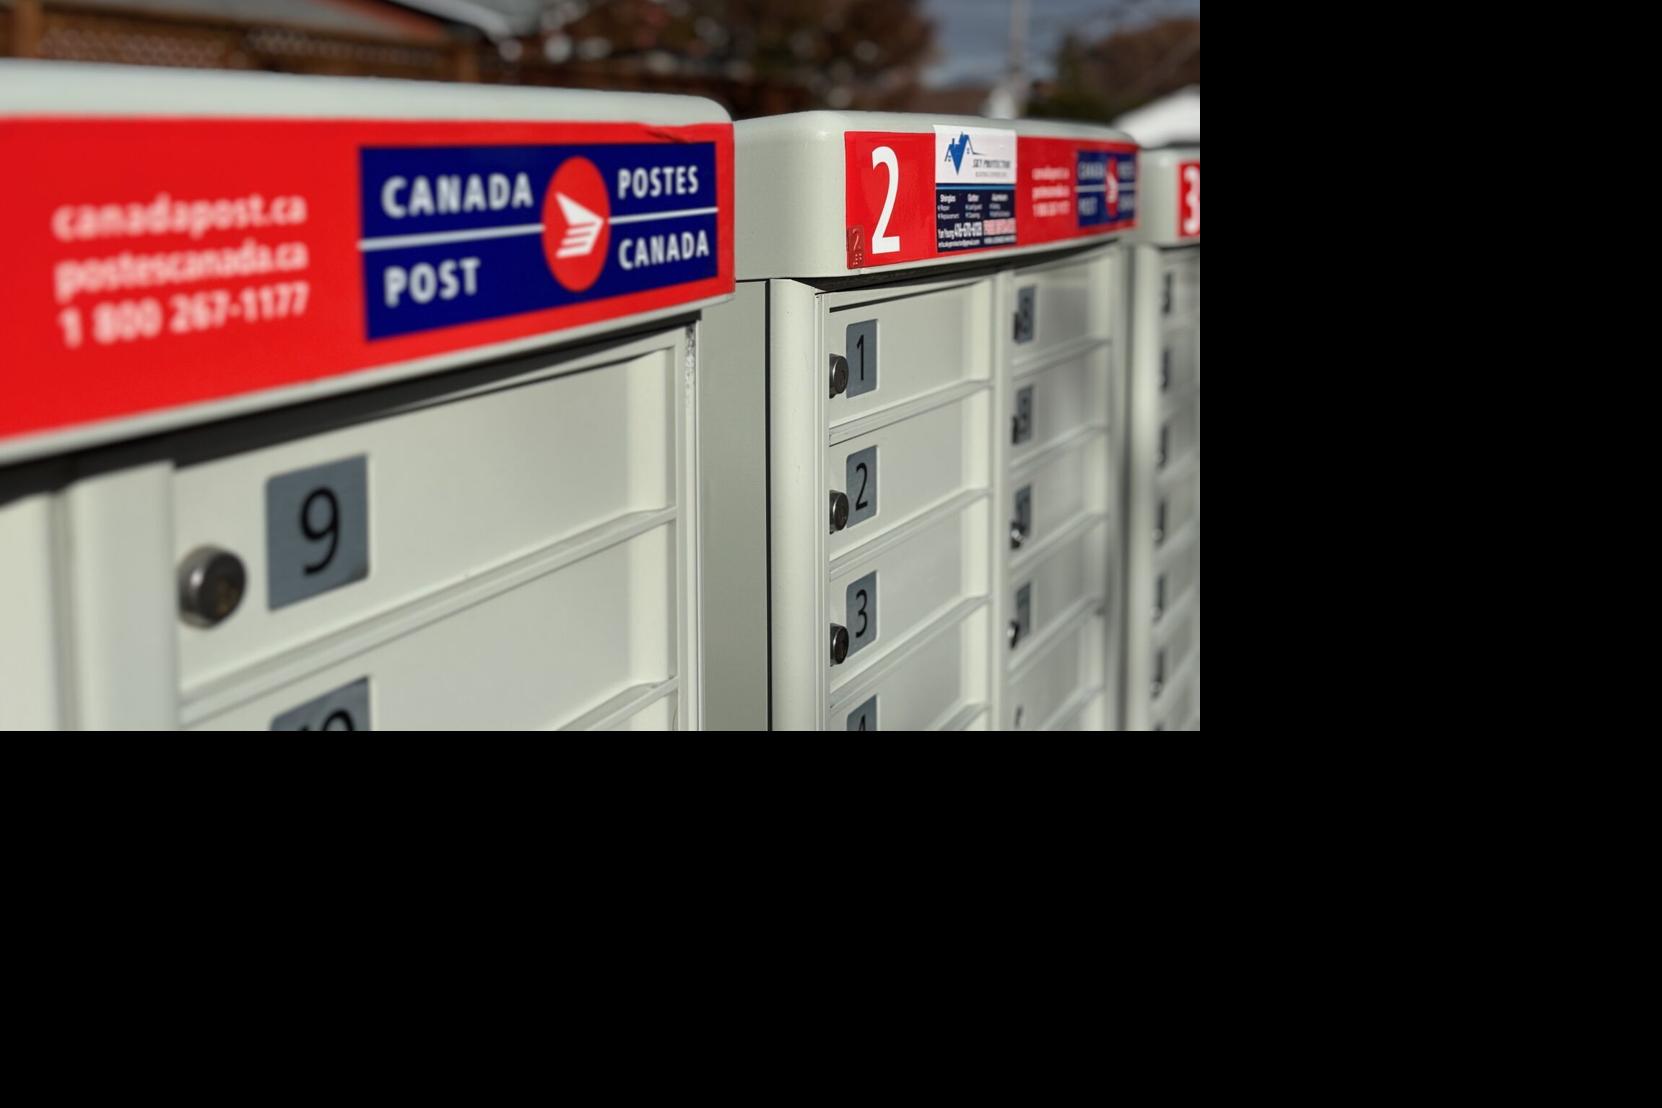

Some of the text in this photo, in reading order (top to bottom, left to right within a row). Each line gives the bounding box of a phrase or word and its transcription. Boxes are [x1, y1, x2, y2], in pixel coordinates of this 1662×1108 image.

[381, 172, 533, 218] CANADA
[617, 165, 698, 199] POSTES
[872, 146, 900, 254] 2
[1183, 165, 1200, 235] 3
[52, 192, 307, 241] canadapost.ca
[55, 238, 309, 302] postescanada.ca
[618, 230, 709, 271] CANADA
[383, 257, 481, 307] POST
[59, 281, 309, 348] 1 800 267-1177
[856, 334, 864, 381] 1
[856, 462, 868, 511] 2
[300, 486, 341, 576] 9
[855, 589, 868, 638] 3
